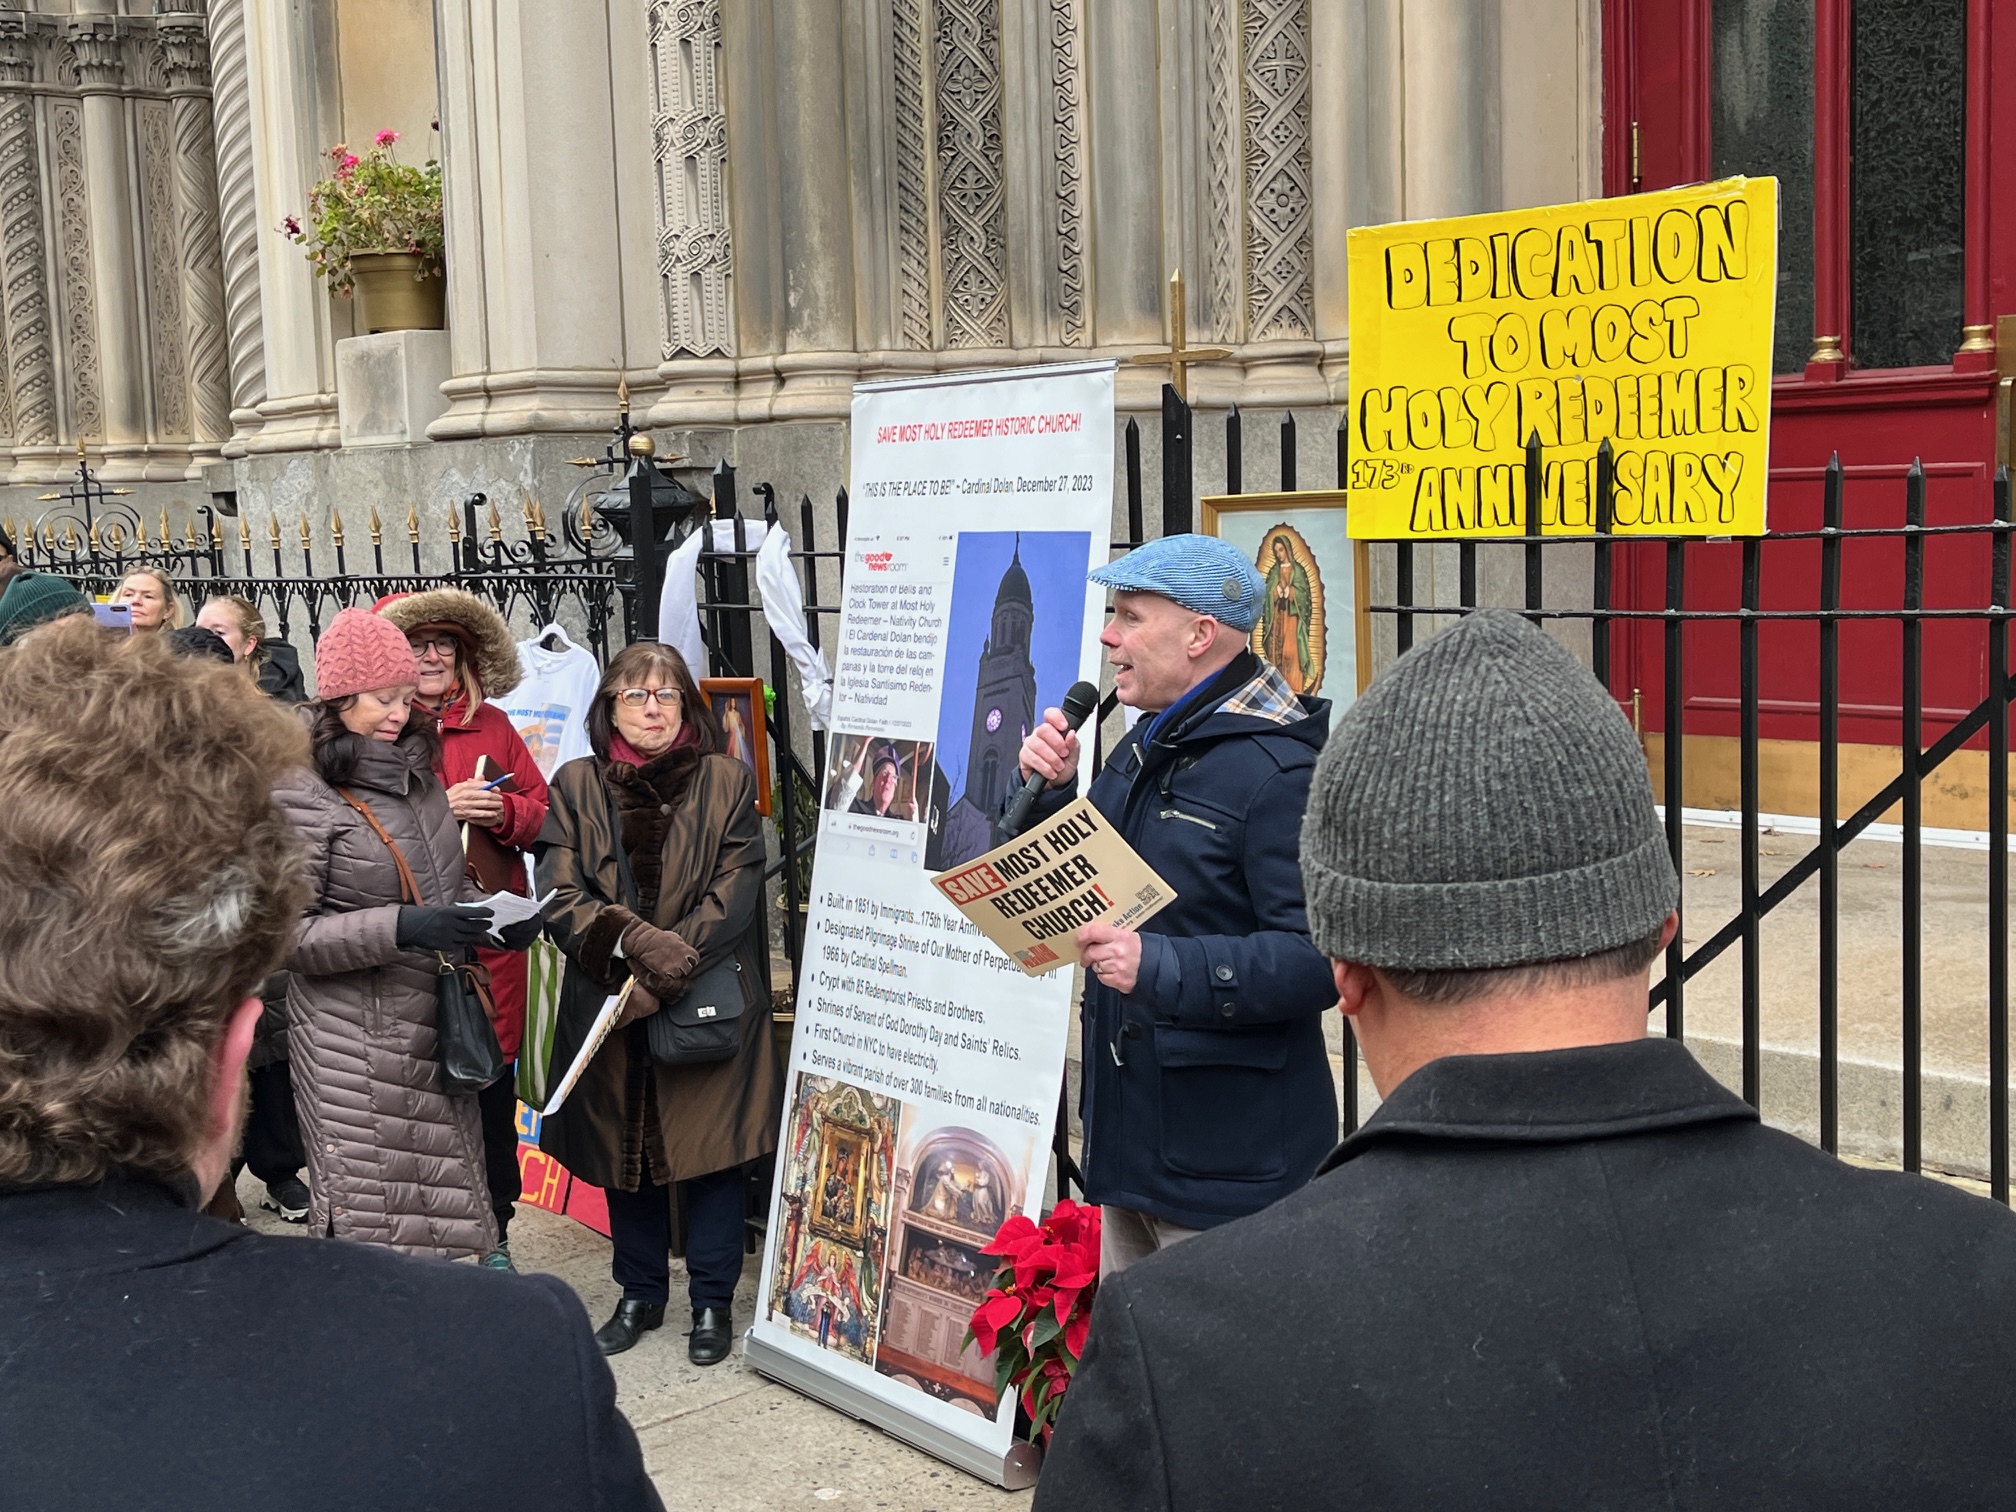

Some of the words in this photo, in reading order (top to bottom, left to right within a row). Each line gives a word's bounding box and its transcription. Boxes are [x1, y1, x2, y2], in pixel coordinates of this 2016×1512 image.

[1386, 200, 1749, 310] DEDICATION
[1448, 312, 1530, 379] TO
[1539, 296, 1699, 370] MOST
[1360, 381, 1509, 452] HOLY
[1517, 364, 1759, 449] REDEEMER
[877, 425, 898, 443] SAVE
[899, 424, 923, 442] MOST
[924, 422, 946, 440] HOLY
[947, 419, 993, 440] REDEEMER
[995, 415, 1036, 437] HISTORIC
[1038, 412, 1082, 434] CHURCH!
[879, 481, 887, 497] IS
[888, 481, 902, 497] THE
[903, 480, 927, 496] PLACE
[928, 479, 939, 496] TO
[961, 478, 993, 494] Cardinal
[993, 477, 1015, 495] Dolan,
[1016, 475, 1058, 493] December
[1058, 474, 1069, 494] 27,
[1071, 474, 1093, 491] 2023
[848, 597, 866, 609] Clock
[868, 598, 889, 610] Tower
[890, 599, 898, 611] at
[899, 599, 918, 611] Most
[919, 600, 935, 614] Holy
[850, 583, 888, 594] Restoration
[889, 584, 898, 595] of
[898, 584, 917, 595] Bells
[918, 585, 933, 595] and
[847, 613, 882, 626] Redeemer
[889, 615, 916, 630] Nativity
[918, 616, 942, 628] Church
[856, 629, 888, 642] Cardenal
[889, 631, 912, 643] Dolan
[841, 662, 861, 673] panas
[868, 662, 876, 674] la
[877, 663, 894, 674] torre
[896, 664, 908, 675] del
[909, 665, 924, 679] reloj
[925, 667, 934, 677] en
[894, 647, 905, 659] de
[906, 648, 917, 660] las
[847, 676, 870, 690] Iglesia
[854, 692, 888, 706] Natividad
[944, 866, 1002, 902] SAVE
[993, 840, 1051, 883] MOST
[1043, 809, 1099, 855] HOLY
[989, 854, 1099, 920] REDEEMER
[827, 892, 844, 910] Built
[845, 894, 853, 911] in
[855, 896, 870, 914] 1851
[870, 900, 880, 921] by
[943, 913, 958, 932] Year
[1021, 883, 1114, 941] CHURCH!
[1122, 903, 1144, 921] Action
[824, 918, 864, 940] Designated
[864, 925, 898, 951] Pilgrimage
[898, 933, 920, 953] Shrine
[921, 938, 931, 955] of
[931, 940, 944, 957] Our
[945, 942, 970, 963] Mother
[972, 948, 983, 966] of
[823, 944, 839, 962] 1966
[840, 948, 850, 968] by
[851, 950, 878, 970] Cardinal
[878, 956, 908, 978] Spellman.
[819, 970, 840, 992] Crypt
[841, 975, 855, 992] with
[865, 981, 906, 1006] Redemptorist
[907, 991, 932, 1013] Priests
[933, 999, 947, 1015] and
[947, 1001, 986, 1024] Brothers.
[817, 996, 844, 1018] Shrines
[845, 1004, 854, 1019] of
[853, 1005, 877, 1026] Servant
[878, 1012, 886, 1027] of
[885, 1013, 899, 1032] God
[899, 1017, 928, 1044] Dorothy
[929, 1025, 943, 1047] Day
[944, 1031, 960, 1047] and
[992, 1038, 1022, 1061] Relics.
[814, 1022, 831, 1041] First
[832, 1027, 856, 1047] Church
[856, 1033, 863, 1050] in
[863, 1035, 878, 1054] NYC
[879, 1041, 886, 1056] to
[886, 1042, 902, 1061] have
[903, 1048, 939, 1075] electricity.
[811, 1049, 836, 1070] Serves
[842, 1058, 864, 1077] vibrant
[864, 1066, 885, 1084] parish
[885, 1071, 894, 1087] of
[893, 1075, 910, 1091] over
[909, 1077, 923, 1096] 300
[924, 1081, 953, 1105] families
[954, 1089, 975, 1110] from
[976, 1095, 988, 1112] all
[988, 1100, 1041, 1126] nationalities.
